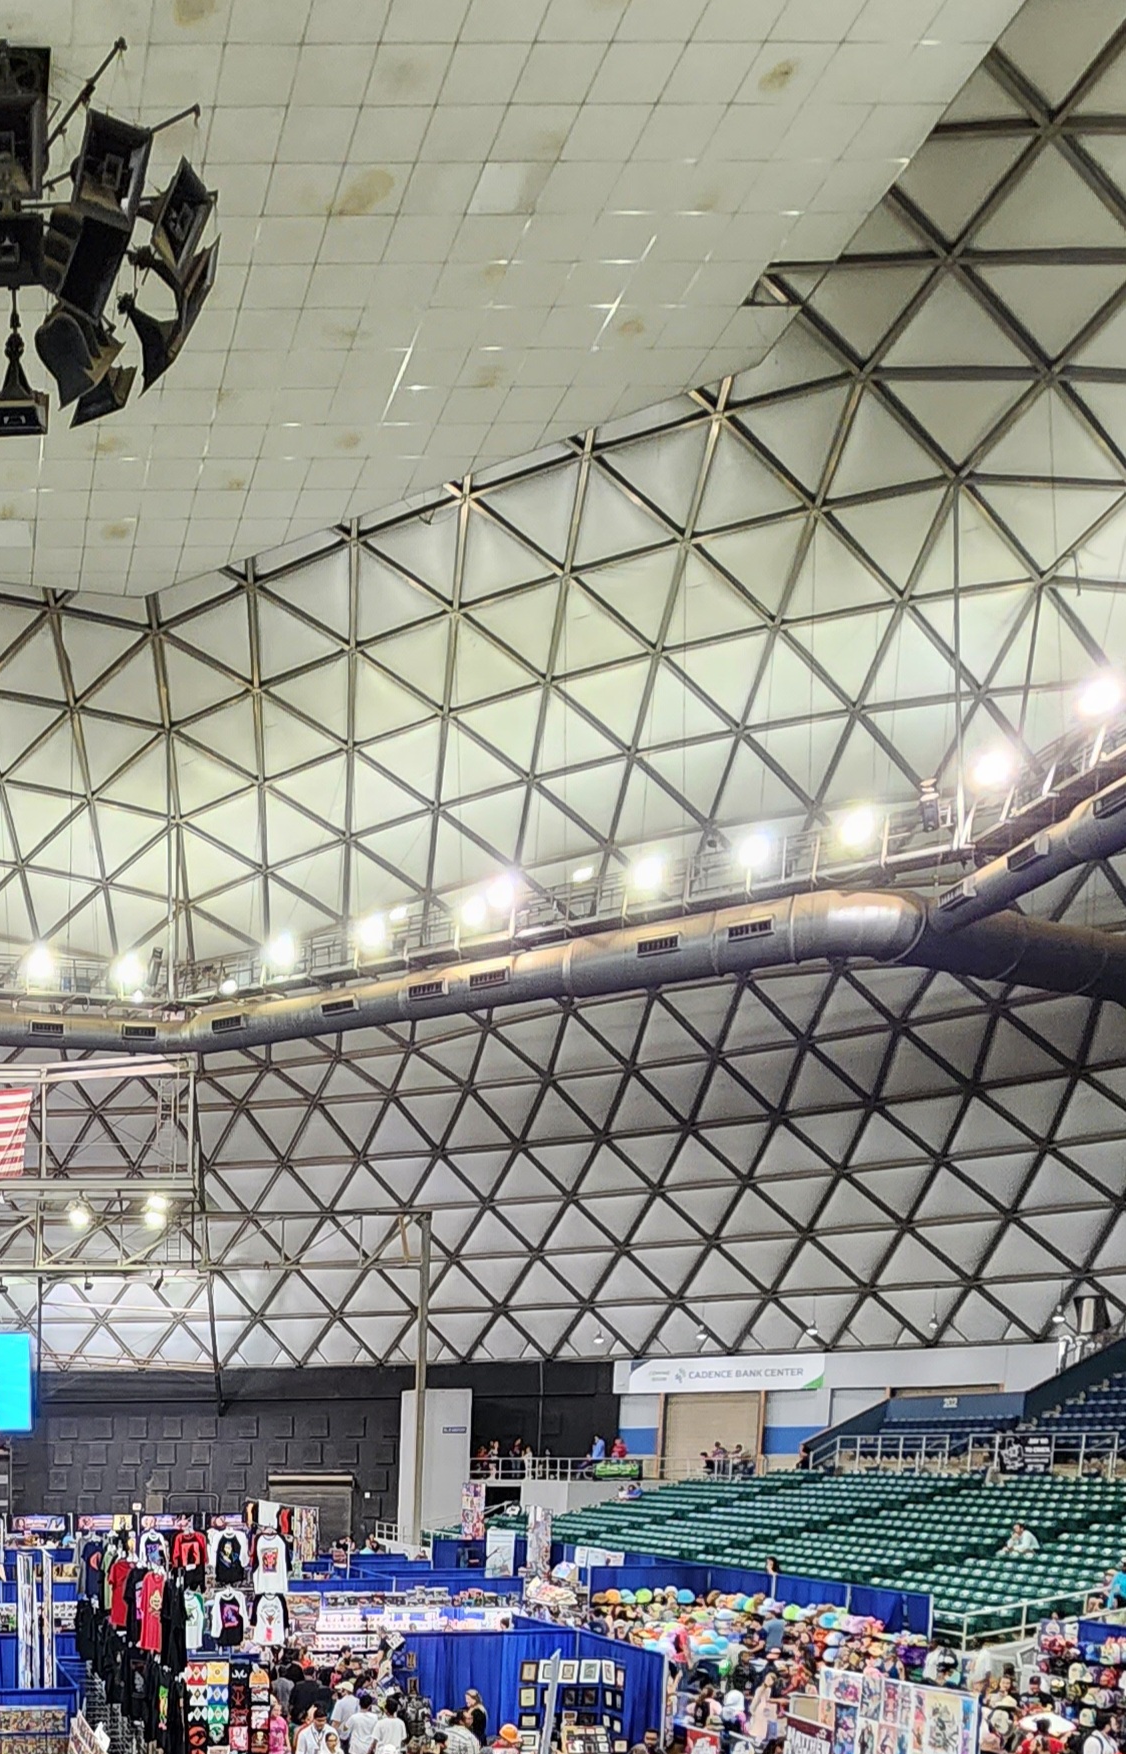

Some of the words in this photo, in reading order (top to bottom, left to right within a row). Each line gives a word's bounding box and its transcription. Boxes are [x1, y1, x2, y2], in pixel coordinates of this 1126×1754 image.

[688, 1370, 733, 1380] CADENCE
[735, 1369, 763, 1379] BANK
[763, 1367, 804, 1377] CENTER
